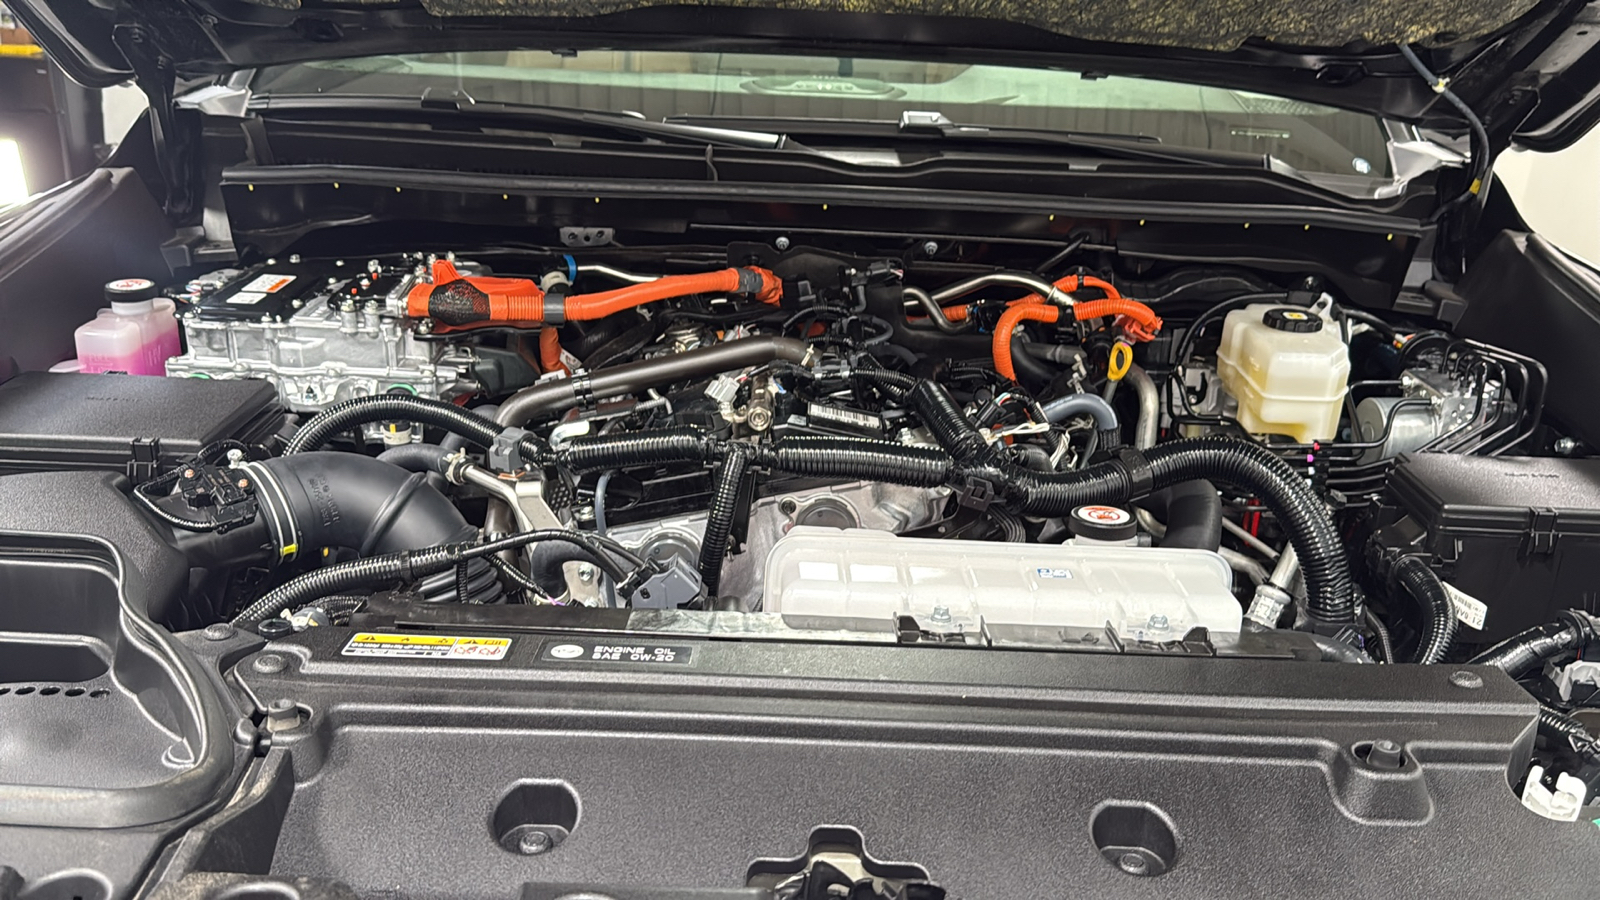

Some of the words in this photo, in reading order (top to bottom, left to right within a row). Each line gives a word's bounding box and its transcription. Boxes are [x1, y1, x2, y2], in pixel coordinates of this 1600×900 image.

[594, 645, 645, 654] ENGINE
[654, 647, 676, 656] OIL
[592, 652, 621, 660] SAE
